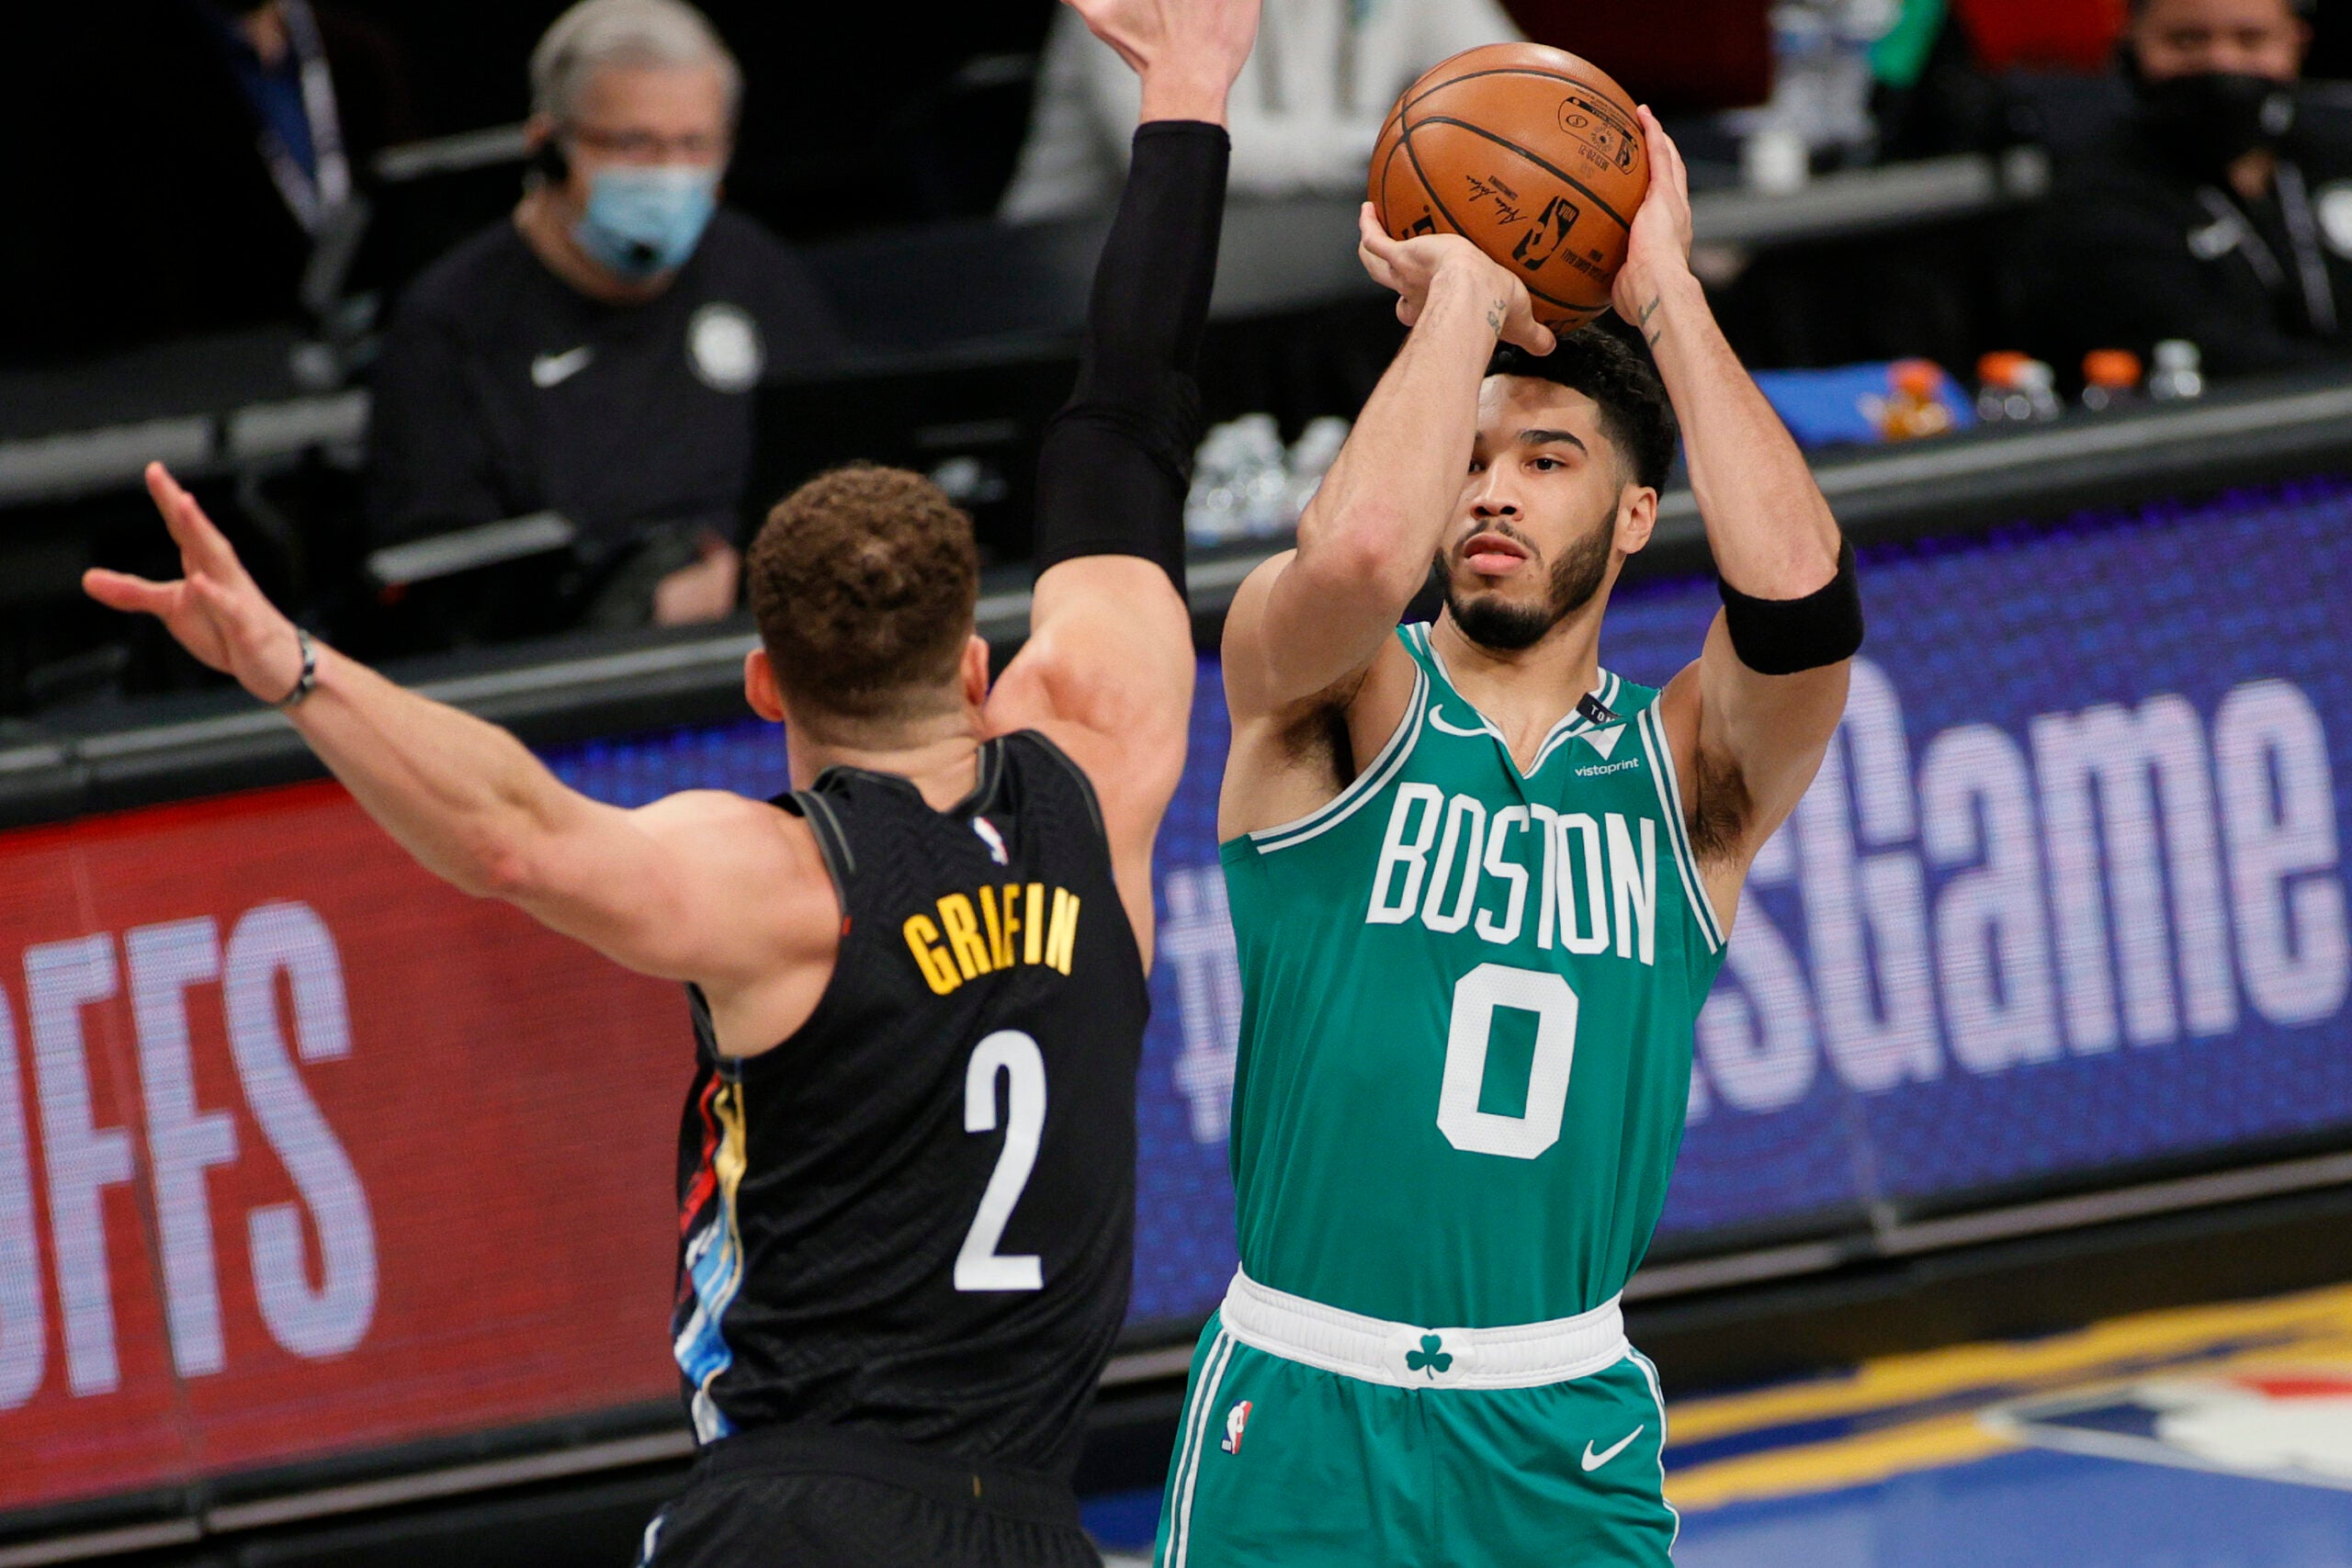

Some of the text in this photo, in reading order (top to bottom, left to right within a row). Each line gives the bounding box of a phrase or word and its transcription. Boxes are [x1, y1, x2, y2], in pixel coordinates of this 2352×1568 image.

[1558, 203, 1577, 222] NBA
[1574, 757, 1640, 777] vistaprint
[1365, 782, 1655, 966] BOSTON
[1436, 962, 1579, 1159] 0
[954, 1029, 1047, 1292] 2
